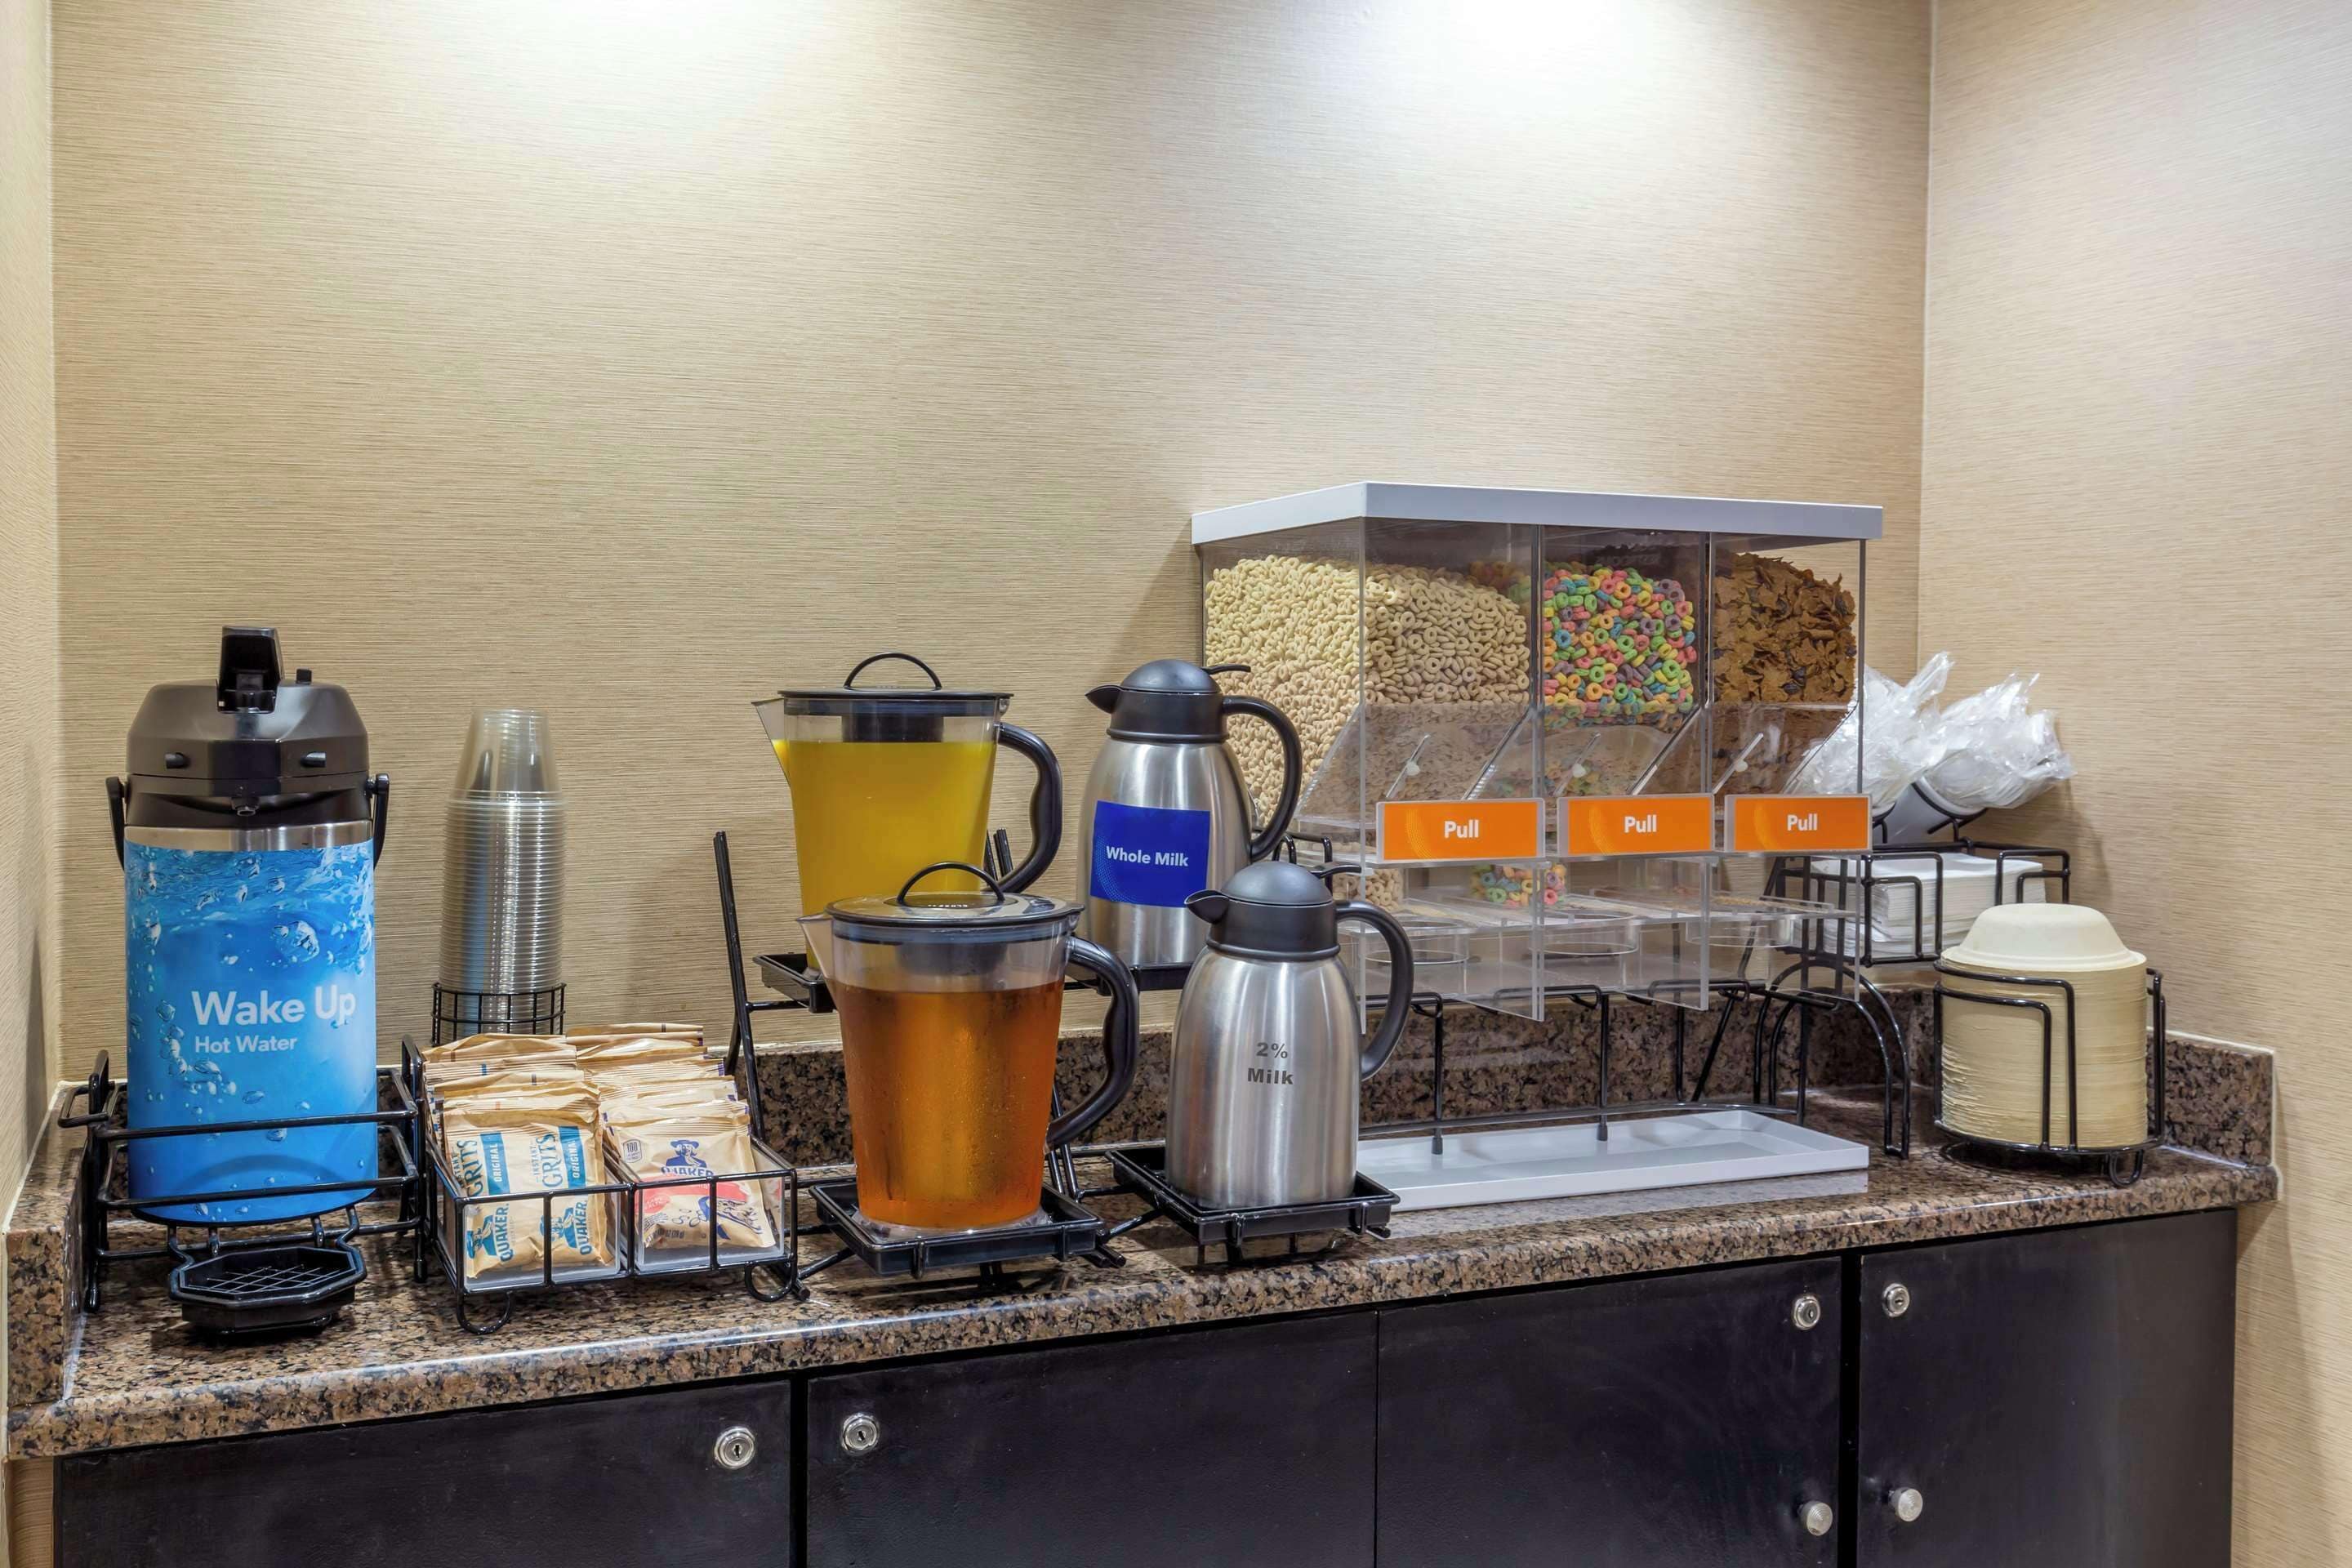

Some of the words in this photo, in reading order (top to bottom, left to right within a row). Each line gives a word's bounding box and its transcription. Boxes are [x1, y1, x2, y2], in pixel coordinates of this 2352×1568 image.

[1445, 819, 1479, 839] Pull
[1624, 814, 1657, 833] Pull
[1788, 813, 1818, 831] Pull
[1106, 845, 1152, 864] Whole
[1155, 852, 1189, 866] Milk
[191, 990, 306, 1026] Wake
[314, 984, 356, 1026] Up
[194, 1035, 231, 1054] Hot
[235, 1035, 298, 1053] Water
[1256, 1042, 1289, 1059] 2%
[1247, 1067, 1294, 1085] Milk
[626, 1141, 639, 1153] 100
[489, 1143, 503, 1183] ORIGINAL
[536, 1133, 564, 1188] GRITS
[495, 1206, 514, 1263] QUAKER
[575, 1201, 592, 1255] QUAKER
